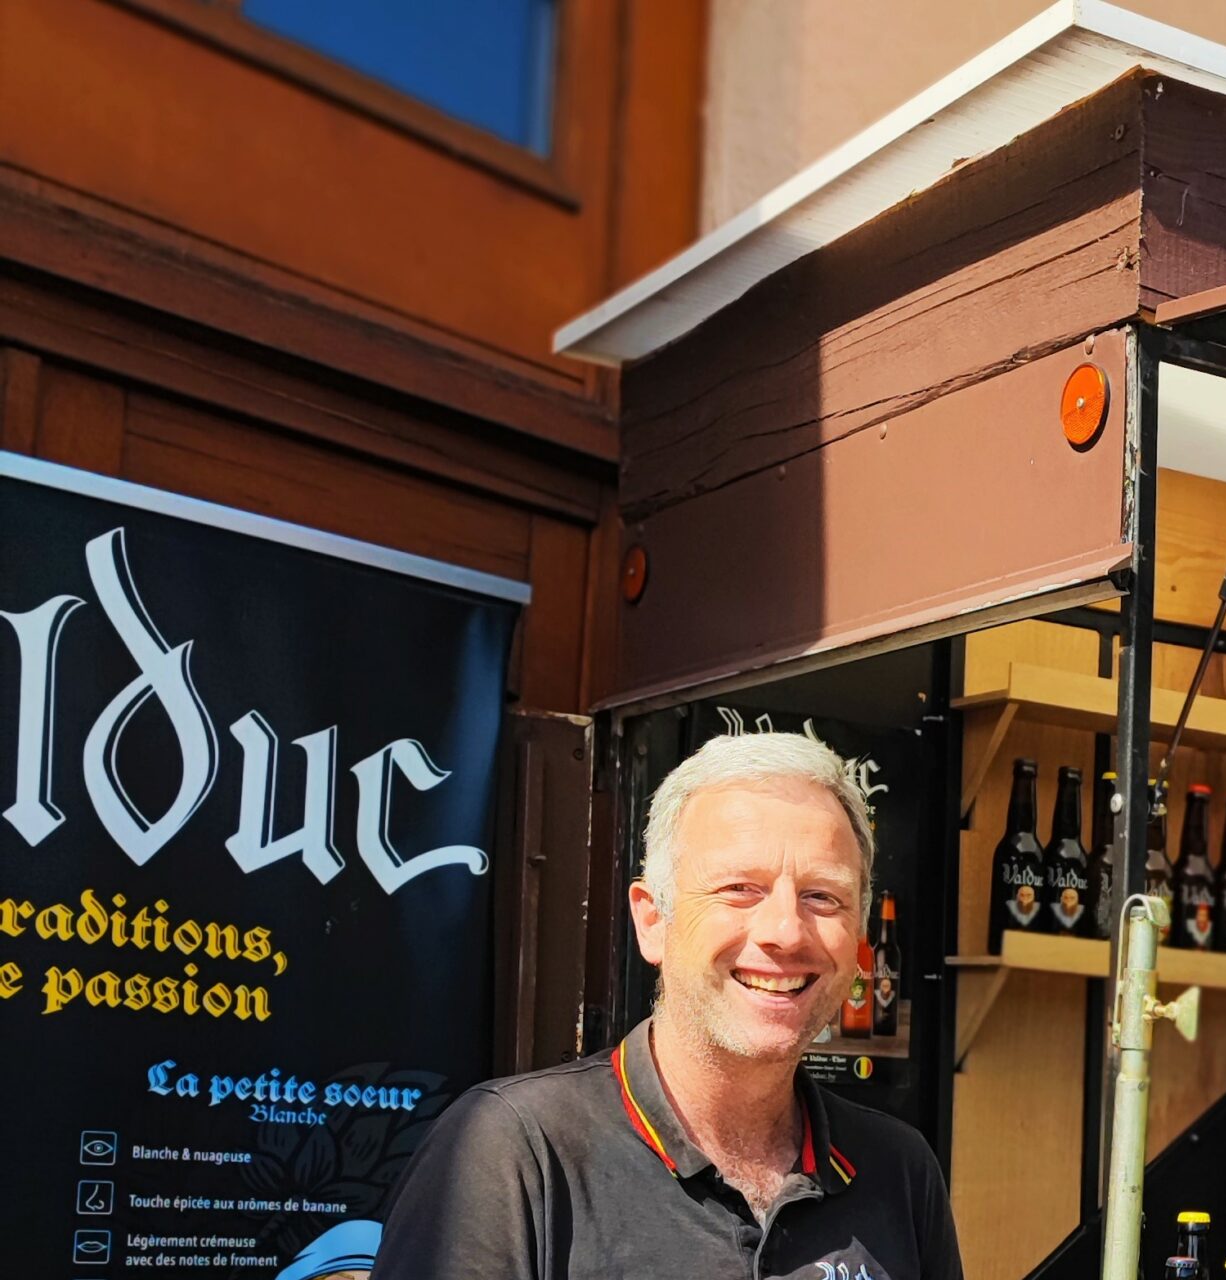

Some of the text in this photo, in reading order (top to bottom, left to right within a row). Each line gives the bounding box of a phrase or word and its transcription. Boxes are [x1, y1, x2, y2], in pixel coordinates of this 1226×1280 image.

[42, 963, 272, 1022] passion
[147, 1059, 421, 1112] La petite soeur
[248, 1104, 327, 1127] Blanche
[132, 1145, 251, 1166] Blanche & nuageuse
[129, 1194, 347, 1213] Touche épicée aux arômes de banane
[127, 1233, 256, 1252] Légèrement crémeuse
[125, 1253, 278, 1267] avec des notes de froment
